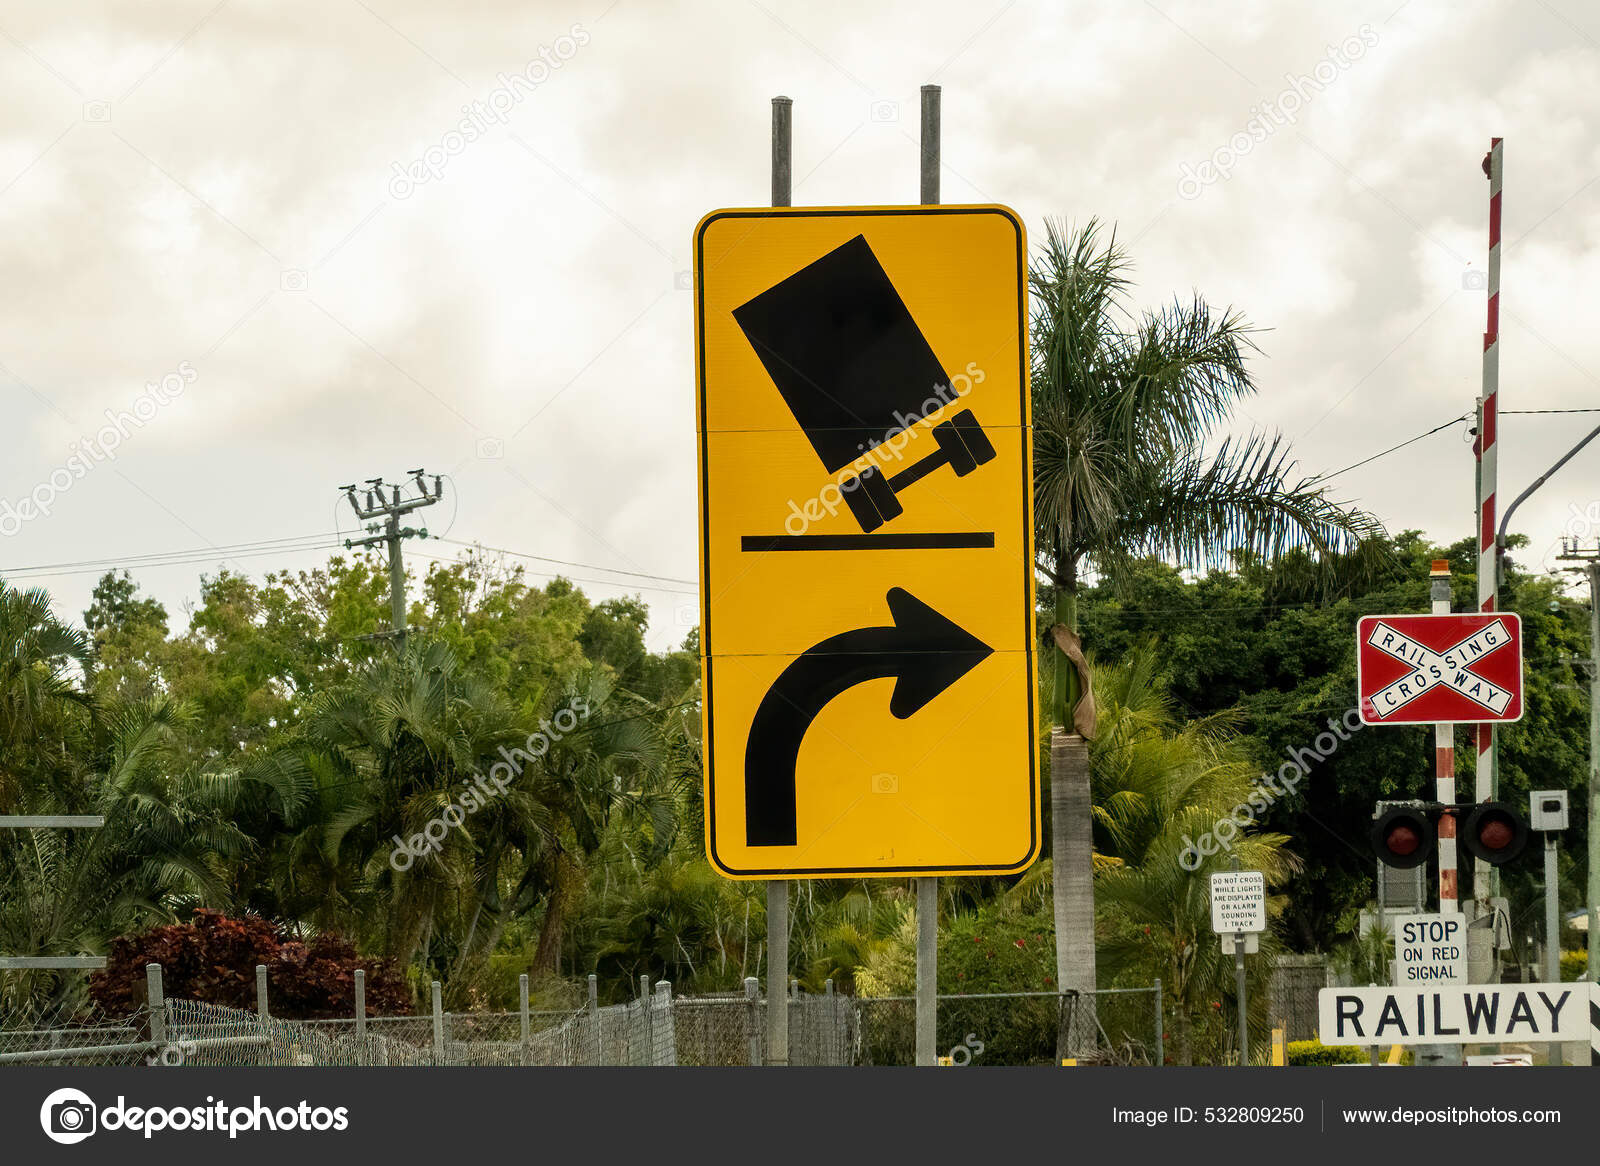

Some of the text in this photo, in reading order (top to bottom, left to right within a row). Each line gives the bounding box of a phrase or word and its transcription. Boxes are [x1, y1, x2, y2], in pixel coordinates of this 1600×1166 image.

[1384, 631, 1497, 706] CROSSING
[1221, 911, 1257, 919] SOUNDING
[1403, 920, 1459, 944] STOP
[1403, 946, 1459, 962] ON RED
[1407, 965, 1457, 980] SIGNAL
[1335, 990, 1572, 1038] RAILWAY
